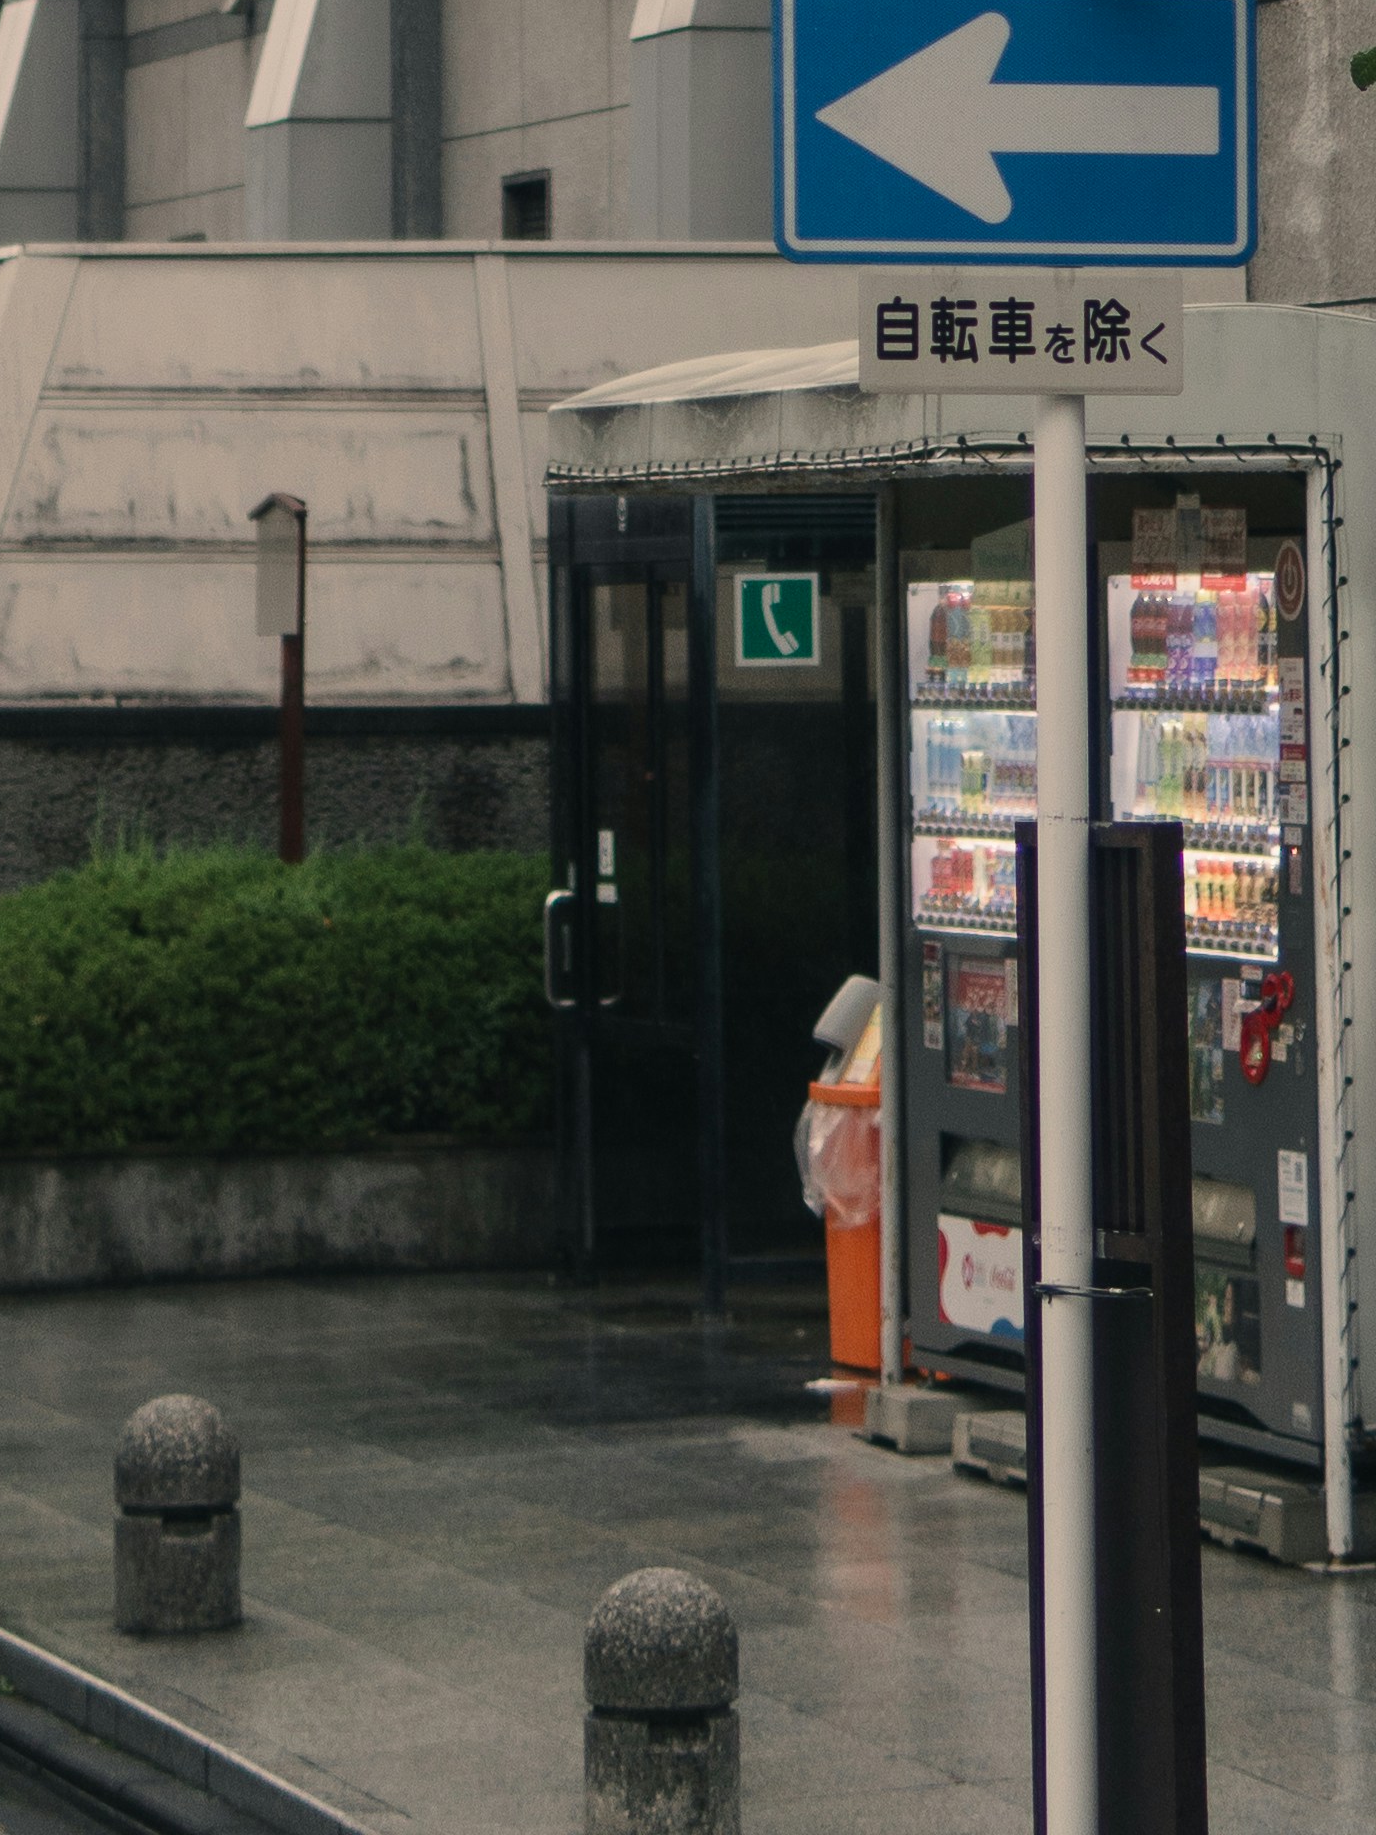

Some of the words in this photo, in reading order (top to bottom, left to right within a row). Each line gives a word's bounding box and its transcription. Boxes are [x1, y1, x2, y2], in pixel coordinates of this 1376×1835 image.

[876, 295, 1169, 365] 自転車を除く
